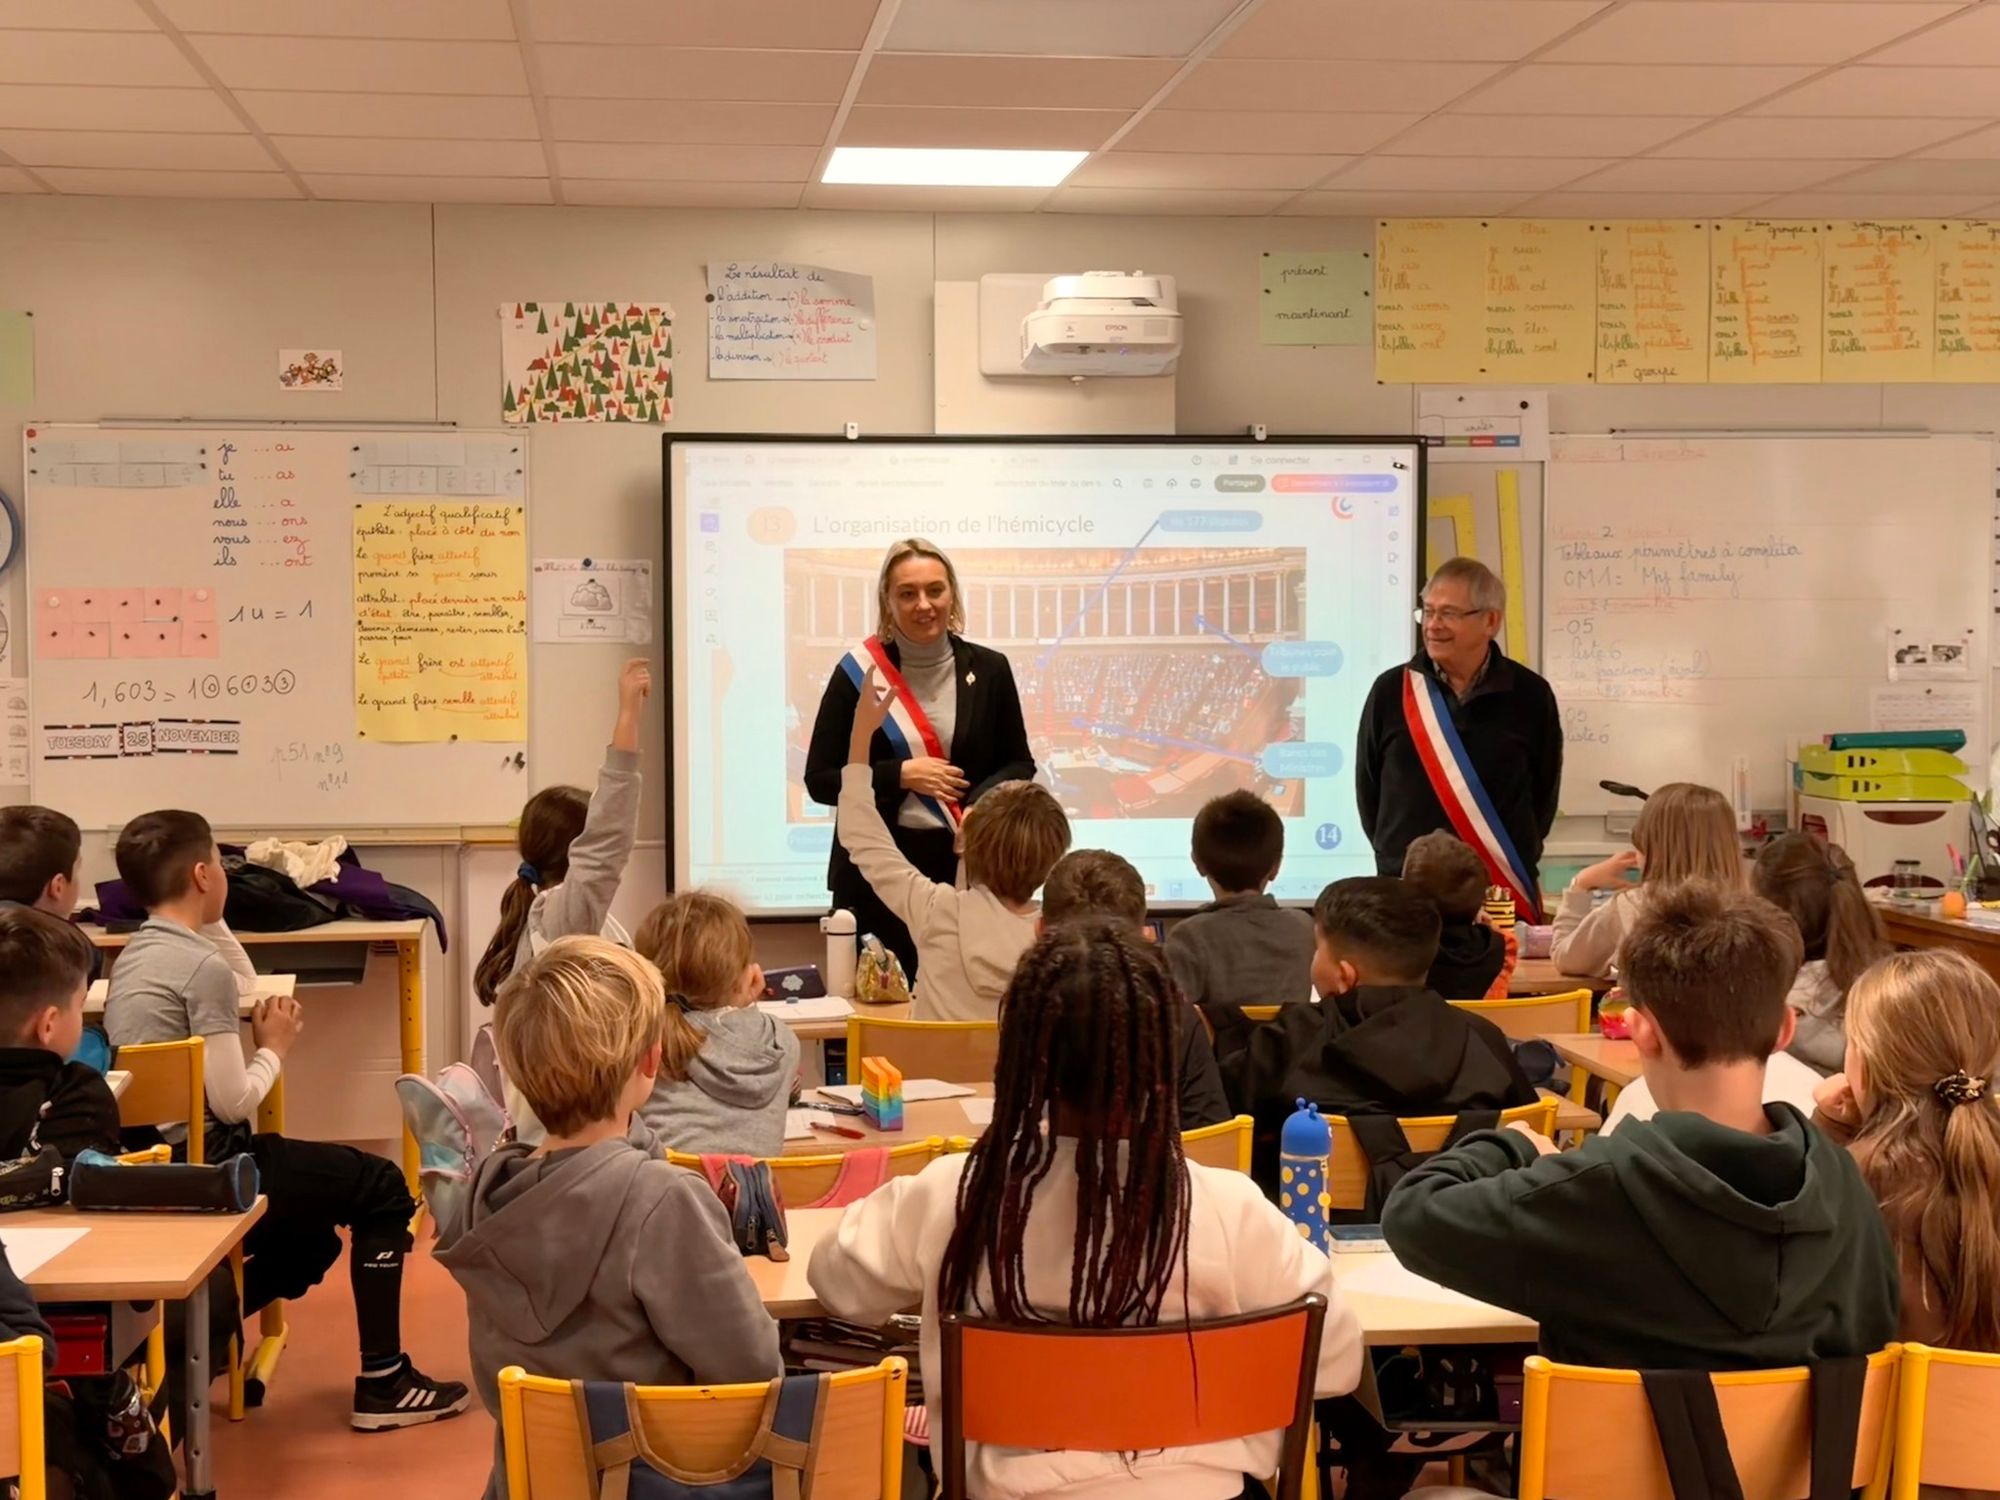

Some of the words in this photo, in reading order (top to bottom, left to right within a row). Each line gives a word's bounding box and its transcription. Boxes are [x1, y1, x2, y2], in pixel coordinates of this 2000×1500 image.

[725, 263, 741, 280] Le
[744, 264, 800, 280] résultat
[806, 270, 824, 282] de
[1281, 264, 1328, 283] présent
[716, 283, 772, 302] l'addition
[1275, 307, 1352, 320] maintenant
[217, 439, 237, 465] je
[275, 442, 295, 452] ai
[218, 468, 235, 481] tu
[276, 471, 295, 480] as
[213, 486, 241, 508] elle
[280, 499, 295, 507] a
[212, 518, 248, 527] nous
[281, 516, 308, 527] ons
[383, 504, 436, 526] L'adjectif
[440, 504, 510, 526] qualificatif
[409, 523, 437, 541] placé
[441, 526, 449, 536] à
[454, 525, 475, 537] côté
[480, 528, 495, 537] du
[813, 514, 949, 537] L'organisation
[957, 514, 981, 533] de
[988, 513, 1095, 537] l'hémicycle
[1602, 526, 1614, 538] 2
[213, 535, 251, 545] vous
[283, 535, 310, 555] ez
[213, 545, 237, 567] ils
[284, 555, 313, 567] ont
[373, 550, 407, 566] grand
[411, 547, 434, 566] frère
[437, 546, 480, 568] attentif
[1679, 560, 1745, 601] family
[299, 600, 313, 619] 1
[409, 592, 438, 610] placé
[418, 653, 442, 673] frère
[449, 659, 465, 668] est
[470, 652, 514, 672] attentif
[82, 680, 158, 708] 1,603
[372, 697, 407, 711] grand
[413, 693, 436, 711] frère
[47, 735, 113, 750] TUESDAY
[126, 731, 150, 747] 25
[158, 728, 240, 744] NOVEMBER
[1319, 827, 1338, 844] 14
